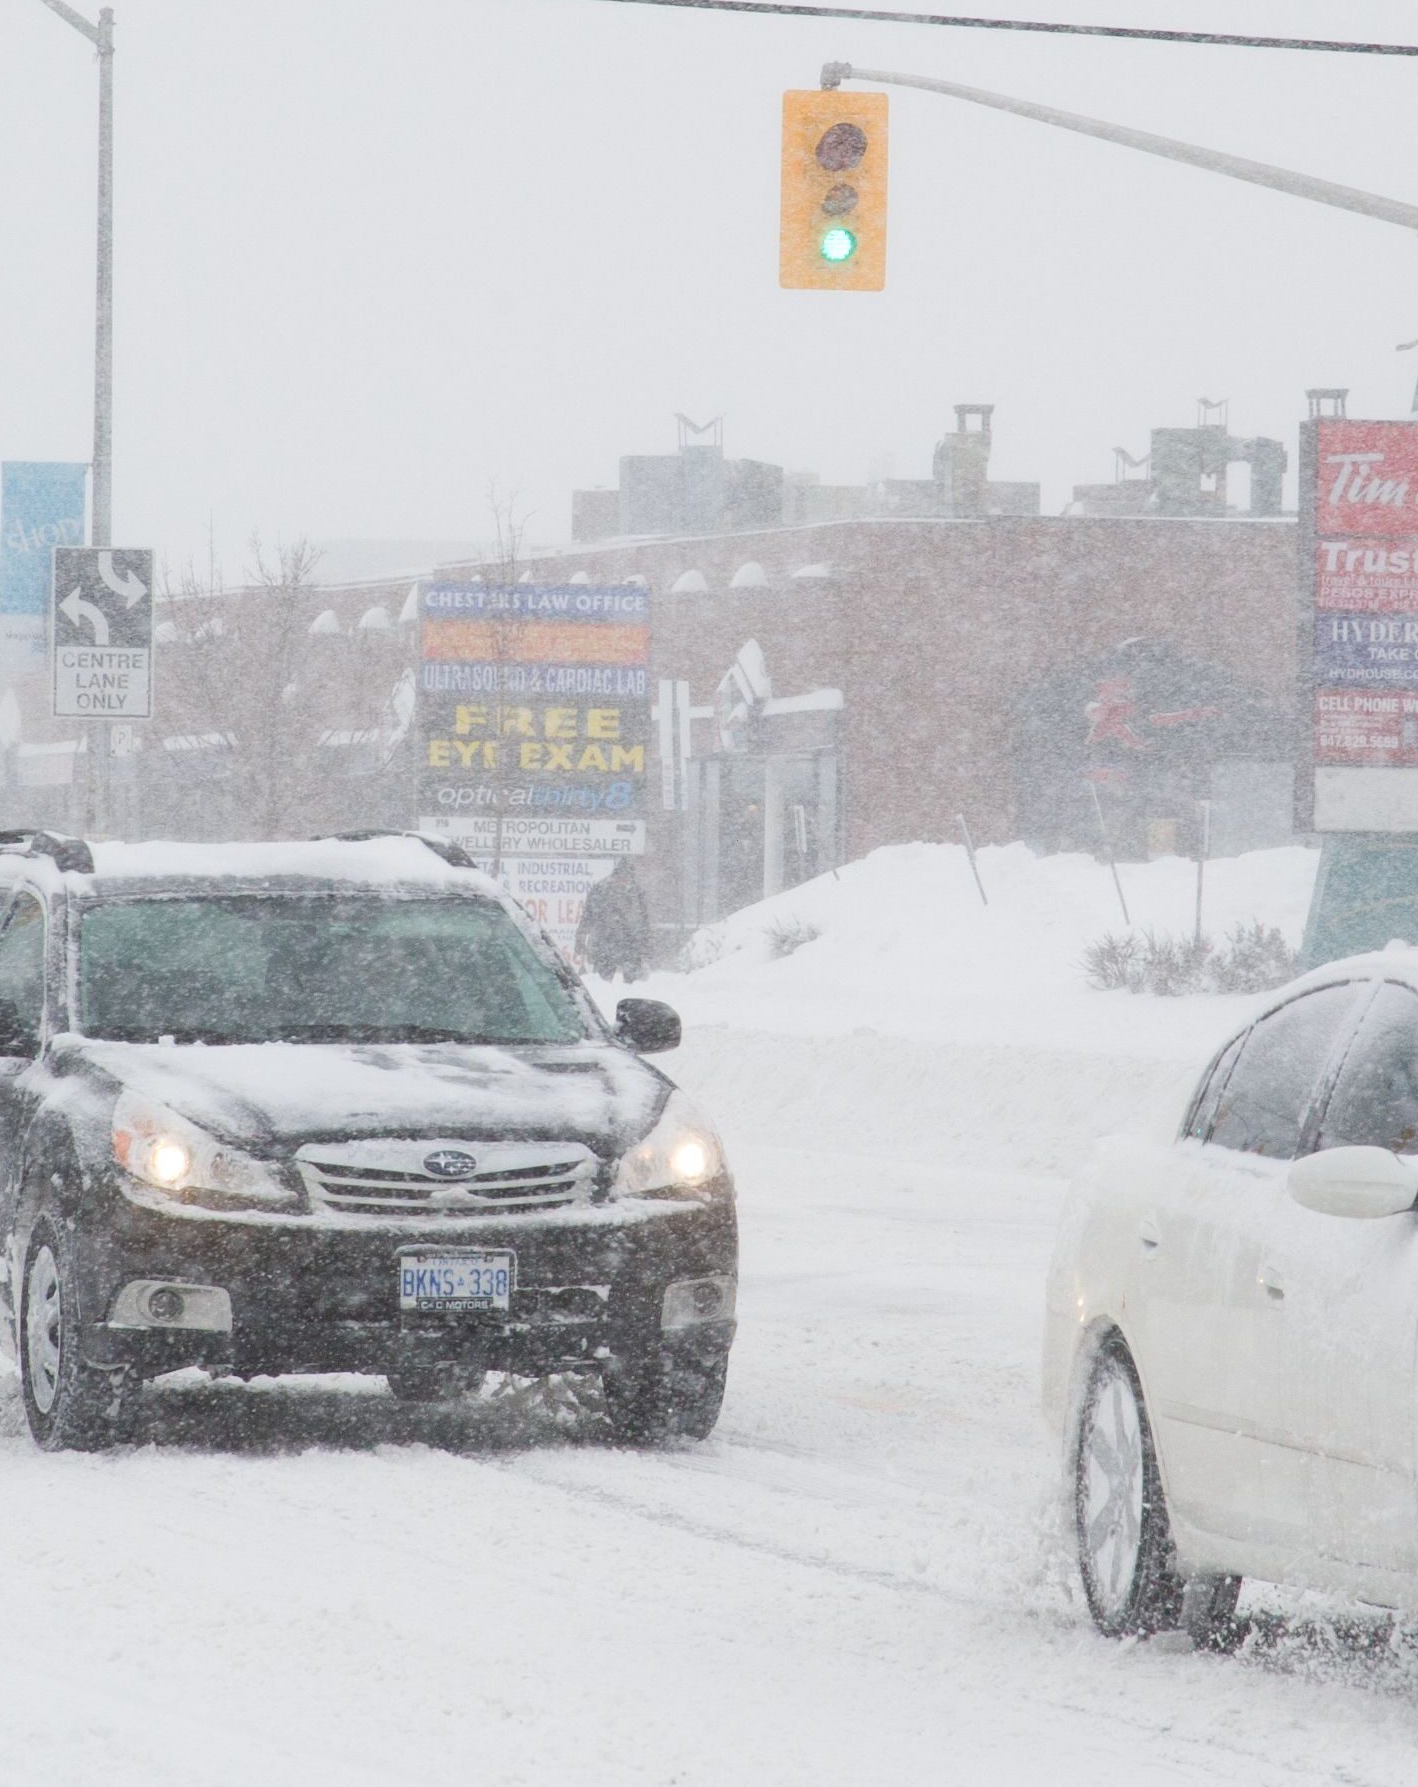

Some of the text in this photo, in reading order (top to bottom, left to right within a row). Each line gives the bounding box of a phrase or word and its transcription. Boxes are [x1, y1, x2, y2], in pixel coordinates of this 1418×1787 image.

[1327, 452, 1410, 508] Tim
[527, 594, 570, 611] LAW
[575, 595, 645, 612] OFFICE
[61, 653, 144, 669] CENTRE
[1367, 647, 1410, 661] TAKE
[74, 673, 130, 690] LANE
[546, 667, 613, 694] CARDIAC
[617, 669, 646, 695] LAB
[75, 693, 129, 710] ONLY
[1318, 696, 1351, 711] CELL
[1354, 697, 1399, 713] PHONE
[455, 704, 621, 739] FREE
[519, 742, 646, 773] EXAM
[473, 820, 591, 836] METROPOLITAN
[526, 837, 631, 851] WHOLESALER
[402, 1268, 508, 1297] BKNS 338
[445, 1300, 490, 1310] MOTORS
